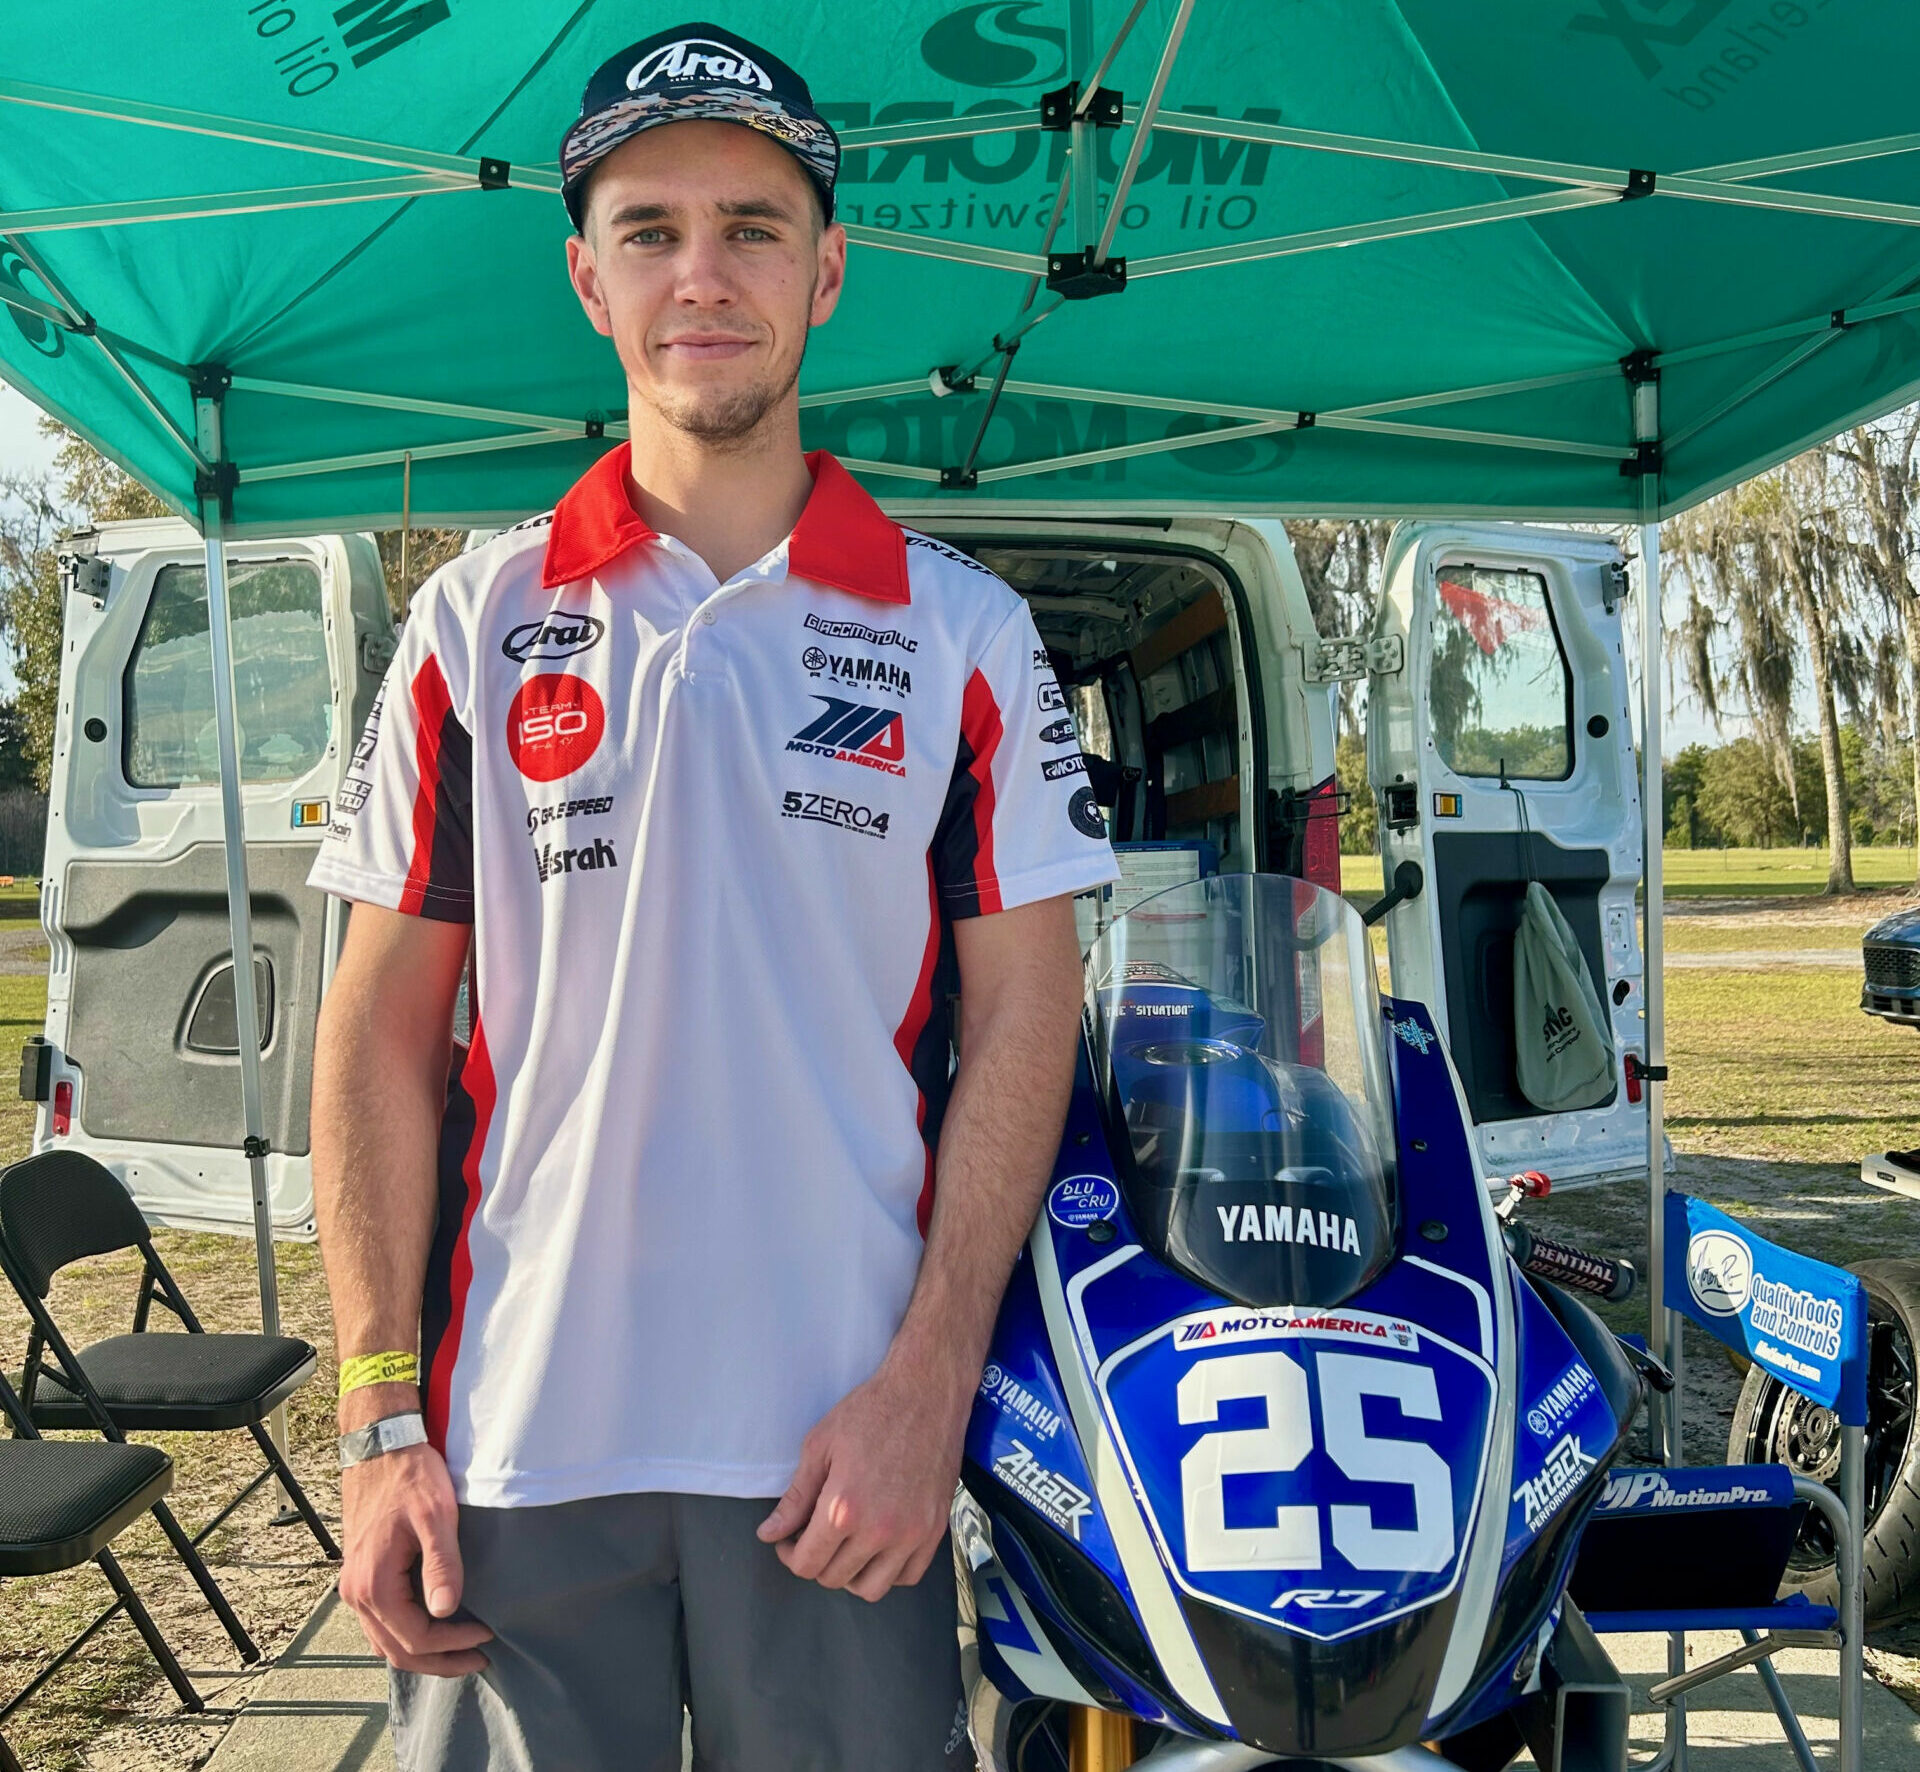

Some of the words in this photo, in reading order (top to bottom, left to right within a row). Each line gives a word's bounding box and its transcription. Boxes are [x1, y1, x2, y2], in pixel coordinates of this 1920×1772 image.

[638, 44, 757, 87] Arai
[829, 654, 912, 693] YAMAHA
[518, 710, 588, 746] ISO
[528, 702, 572, 715] TEAM
[784, 740, 907, 778] MOTOAMERICA
[782, 790, 890, 834] 5ZERO4
[1216, 1204, 1362, 1257] YAMAHA
[1533, 1243, 1614, 1283] RENTHAL
[1752, 1275, 1800, 1321] Quality
[1800, 1293, 1841, 1330] Tools
[1220, 1316, 1388, 1338] MOTOAMERICA
[1753, 1305, 1778, 1332] and
[1778, 1313, 1838, 1357] Controls
[979, 1386, 1046, 1442] RACING
[997, 1375, 1062, 1439] YAMAHA
[1539, 1362, 1593, 1421] YAMAHA
[1176, 1350, 1456, 1575] 25
[992, 1462, 1070, 1530] PERFORMANCE
[1528, 1464, 1588, 1533] PERFORMANCE
[1270, 1589, 1387, 1609] R7
